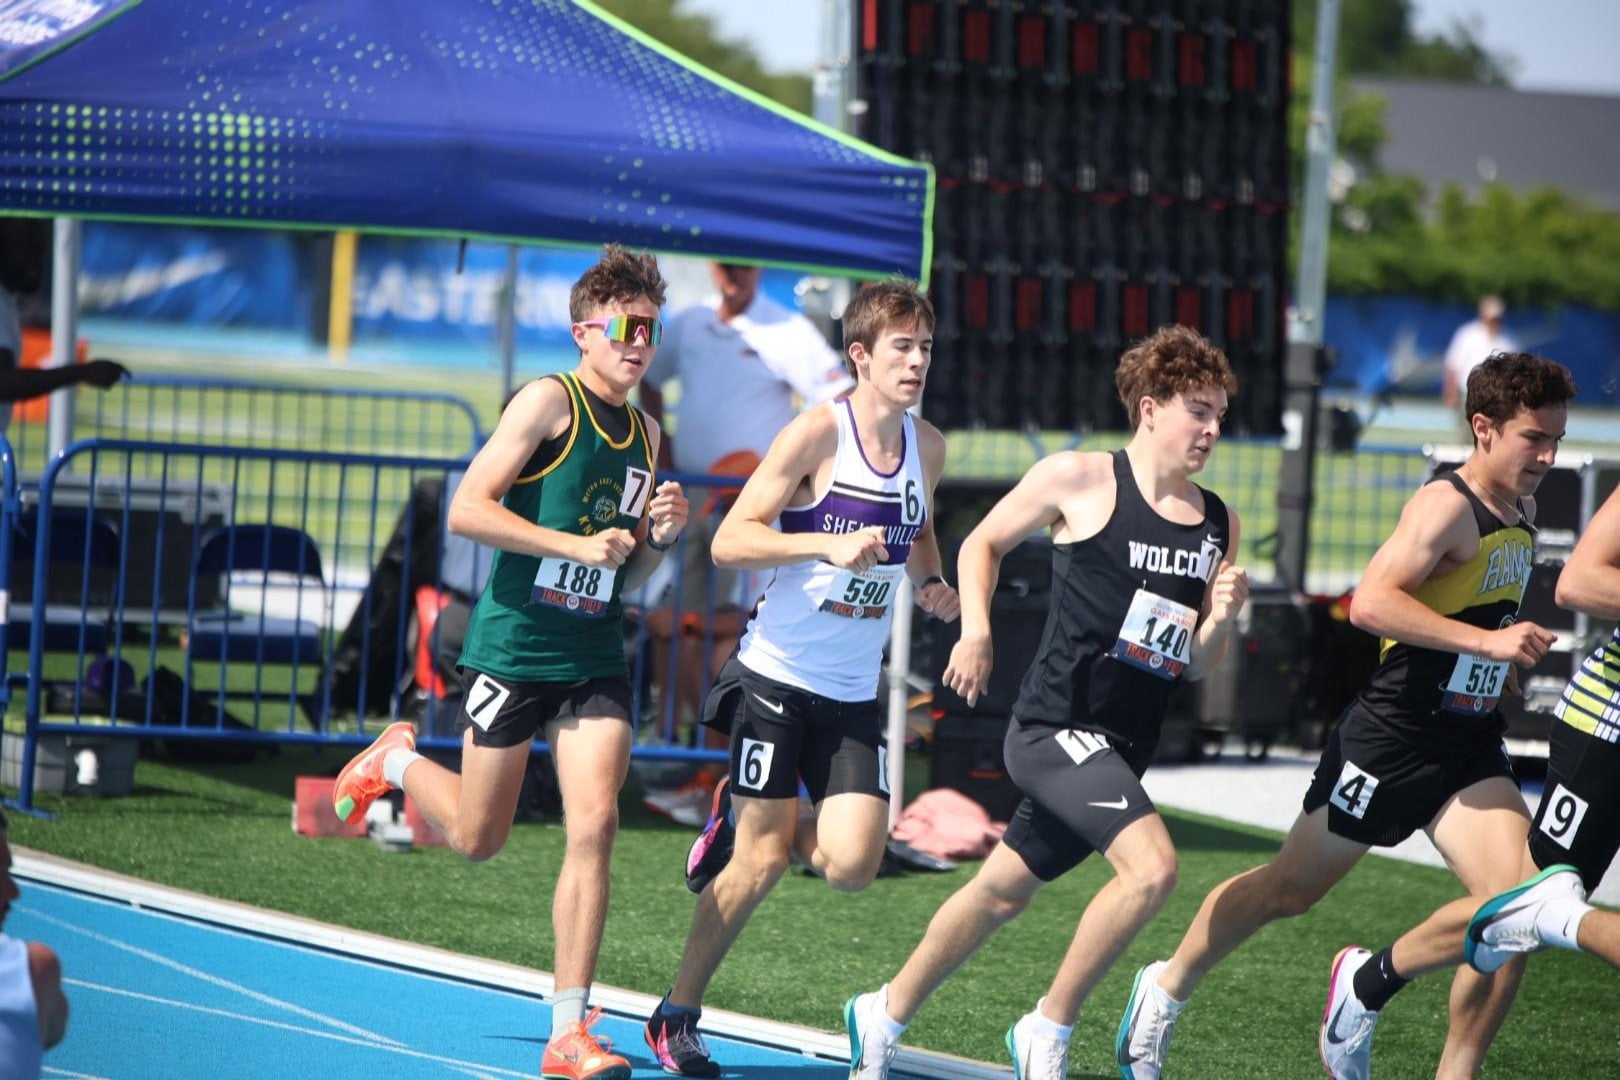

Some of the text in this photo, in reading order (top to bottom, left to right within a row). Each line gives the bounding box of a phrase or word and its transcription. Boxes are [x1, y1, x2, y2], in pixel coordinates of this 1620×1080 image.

[631, 471, 647, 513] 7
[905, 479, 920, 522] 6
[543, 588, 567, 606] TRACK
[554, 562, 601, 597] 188
[843, 576, 891, 606] 590
[1139, 617, 1188, 659] 140
[1466, 663, 1501, 695] 515
[470, 680, 502, 718] 7
[744, 742, 765, 786] 6
[1337, 774, 1368, 811] 4
[1549, 795, 1577, 838] 9
